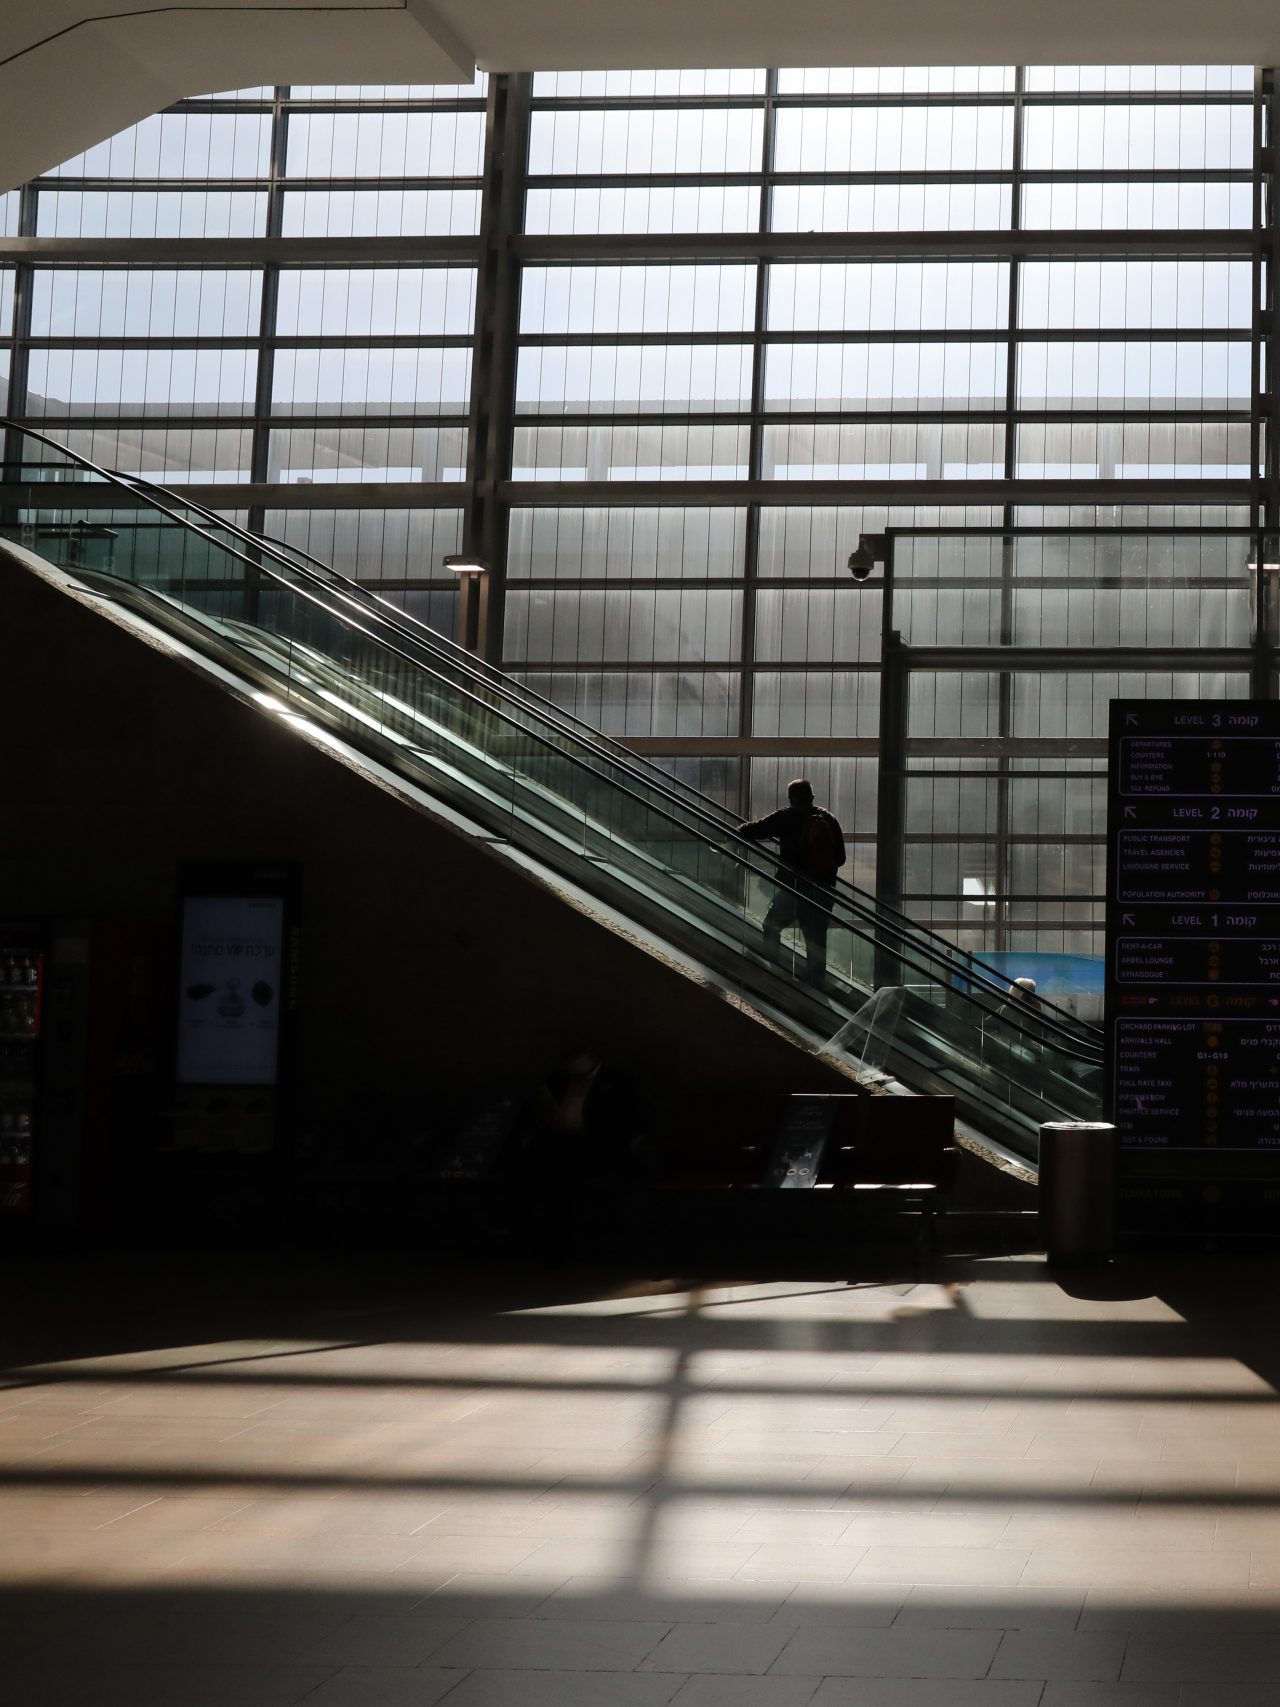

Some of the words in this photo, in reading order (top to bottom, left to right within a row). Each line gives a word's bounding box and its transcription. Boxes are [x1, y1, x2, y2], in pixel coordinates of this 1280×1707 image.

[1174, 715, 1205, 725] LEVEL
[1212, 714, 1221, 727] 3
[1228, 715, 1259, 728] קומה
[1173, 808, 1203, 818] LEVEL
[1210, 807, 1221, 820] 2
[1227, 808, 1258, 820] קומה
[1166, 891, 1205, 899] AUTHORITY
[1172, 915, 1202, 925] LEVEL
[1211, 914, 1218, 927] 1
[1226, 916, 1257, 927] קומה
